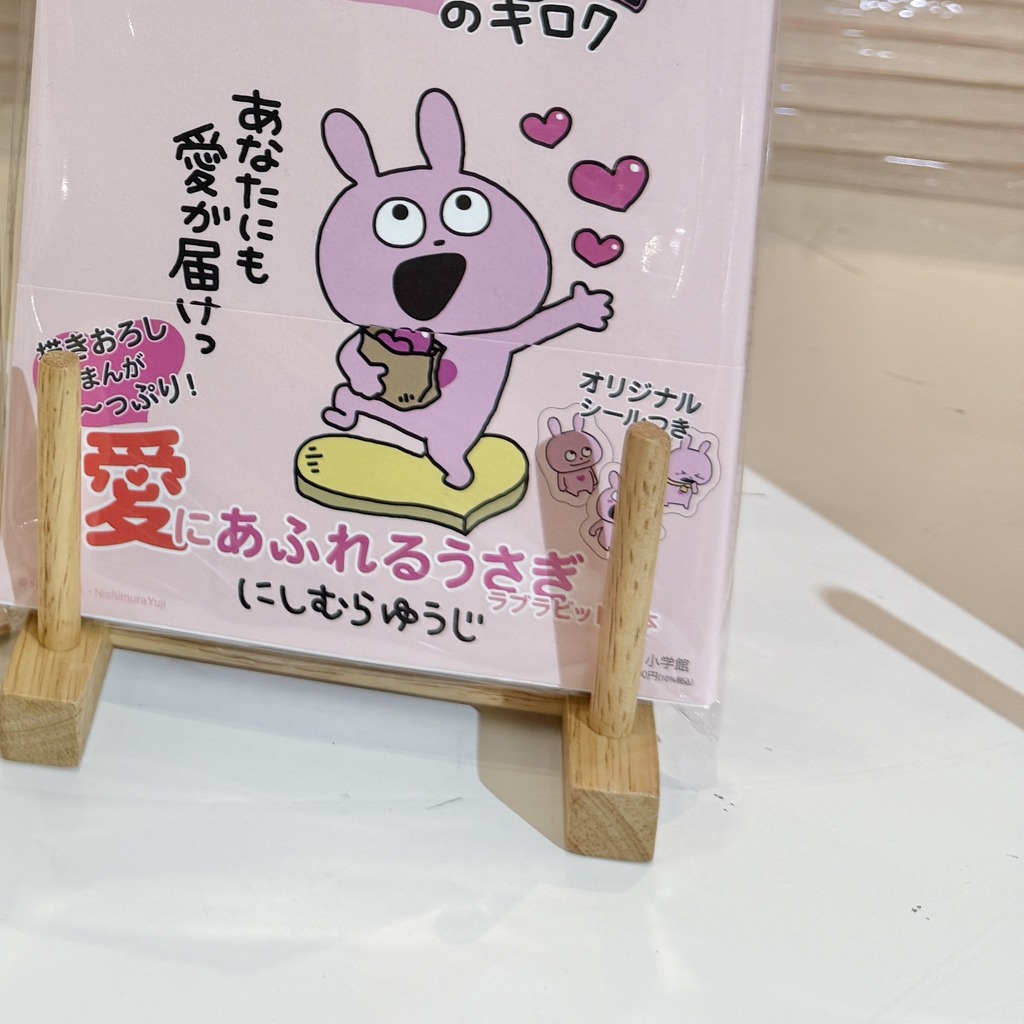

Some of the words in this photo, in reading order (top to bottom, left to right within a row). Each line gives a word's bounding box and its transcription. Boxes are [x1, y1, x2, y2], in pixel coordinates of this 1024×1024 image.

[169, 122, 230, 355] 愛が届けっ
[231, 89, 283, 285] あなたにも
[579, 371, 702, 414] オリジナル
[82, 429, 584, 600] 愛にあふれるうさぎ
[238, 578, 484, 643] にしむらゆうじ
[645, 654, 690, 673] 小学館
